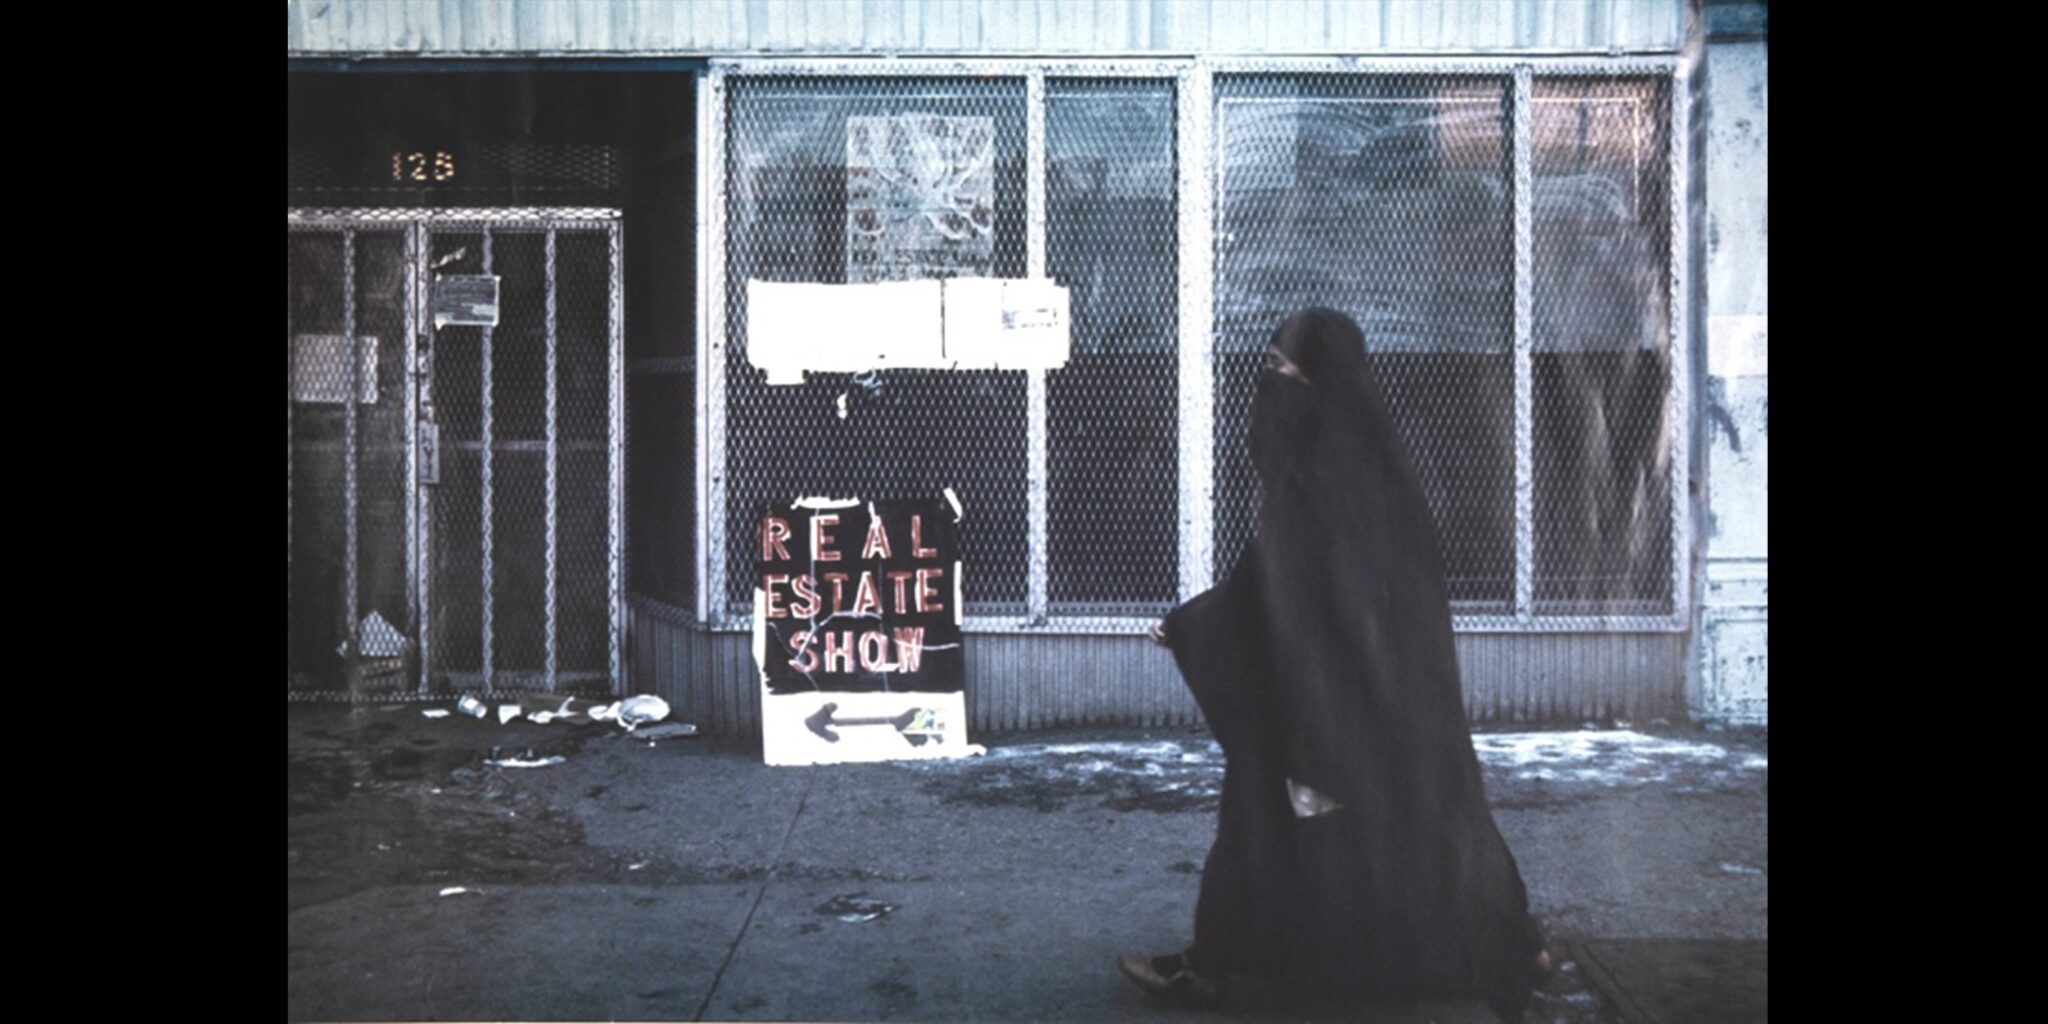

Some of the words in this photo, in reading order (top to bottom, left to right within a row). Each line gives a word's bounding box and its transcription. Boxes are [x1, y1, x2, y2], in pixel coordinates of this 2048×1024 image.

[762, 514, 938, 562] REAL
[764, 568, 944, 619] ESTATE
[788, 626, 925, 674] SHOW
